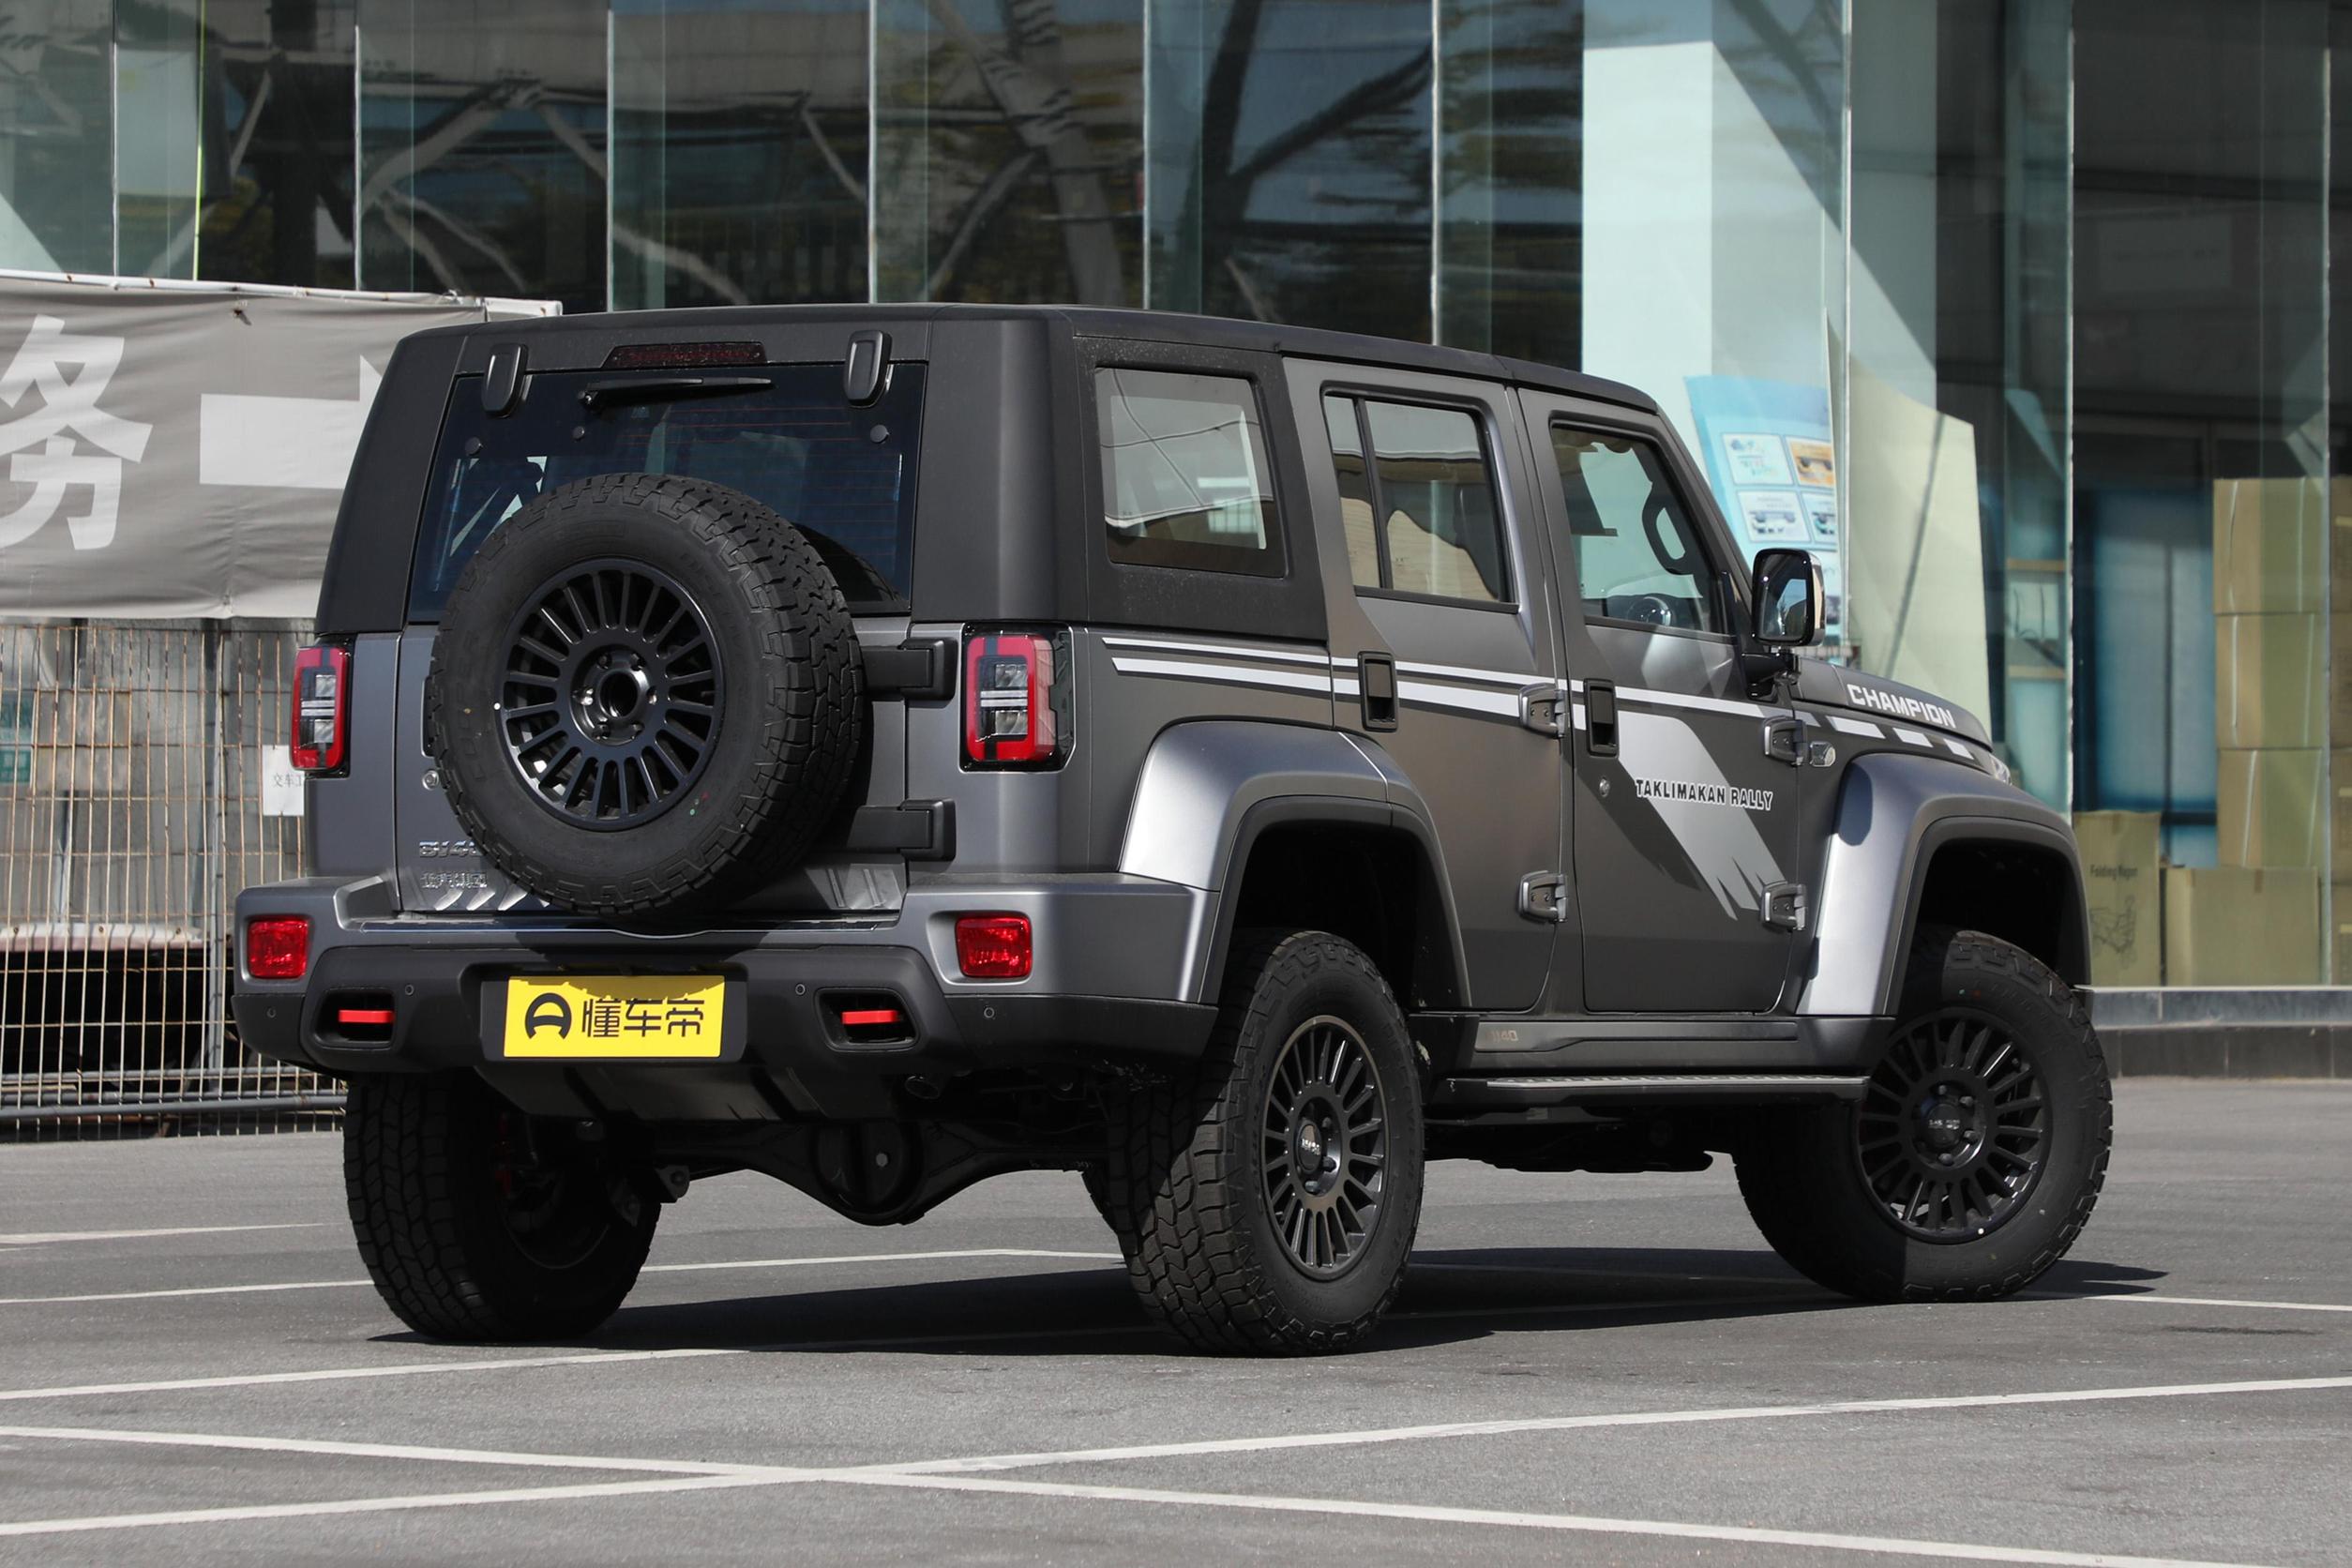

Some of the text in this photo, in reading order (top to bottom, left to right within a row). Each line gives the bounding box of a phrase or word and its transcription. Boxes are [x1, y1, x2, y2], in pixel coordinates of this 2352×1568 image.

[0, 314, 153, 551] 务
[1847, 684, 1956, 729] CHAMPION
[1636, 777, 1773, 811] TAKLIMAKAN RALLY
[581, 997, 705, 1038] 懂车帝
